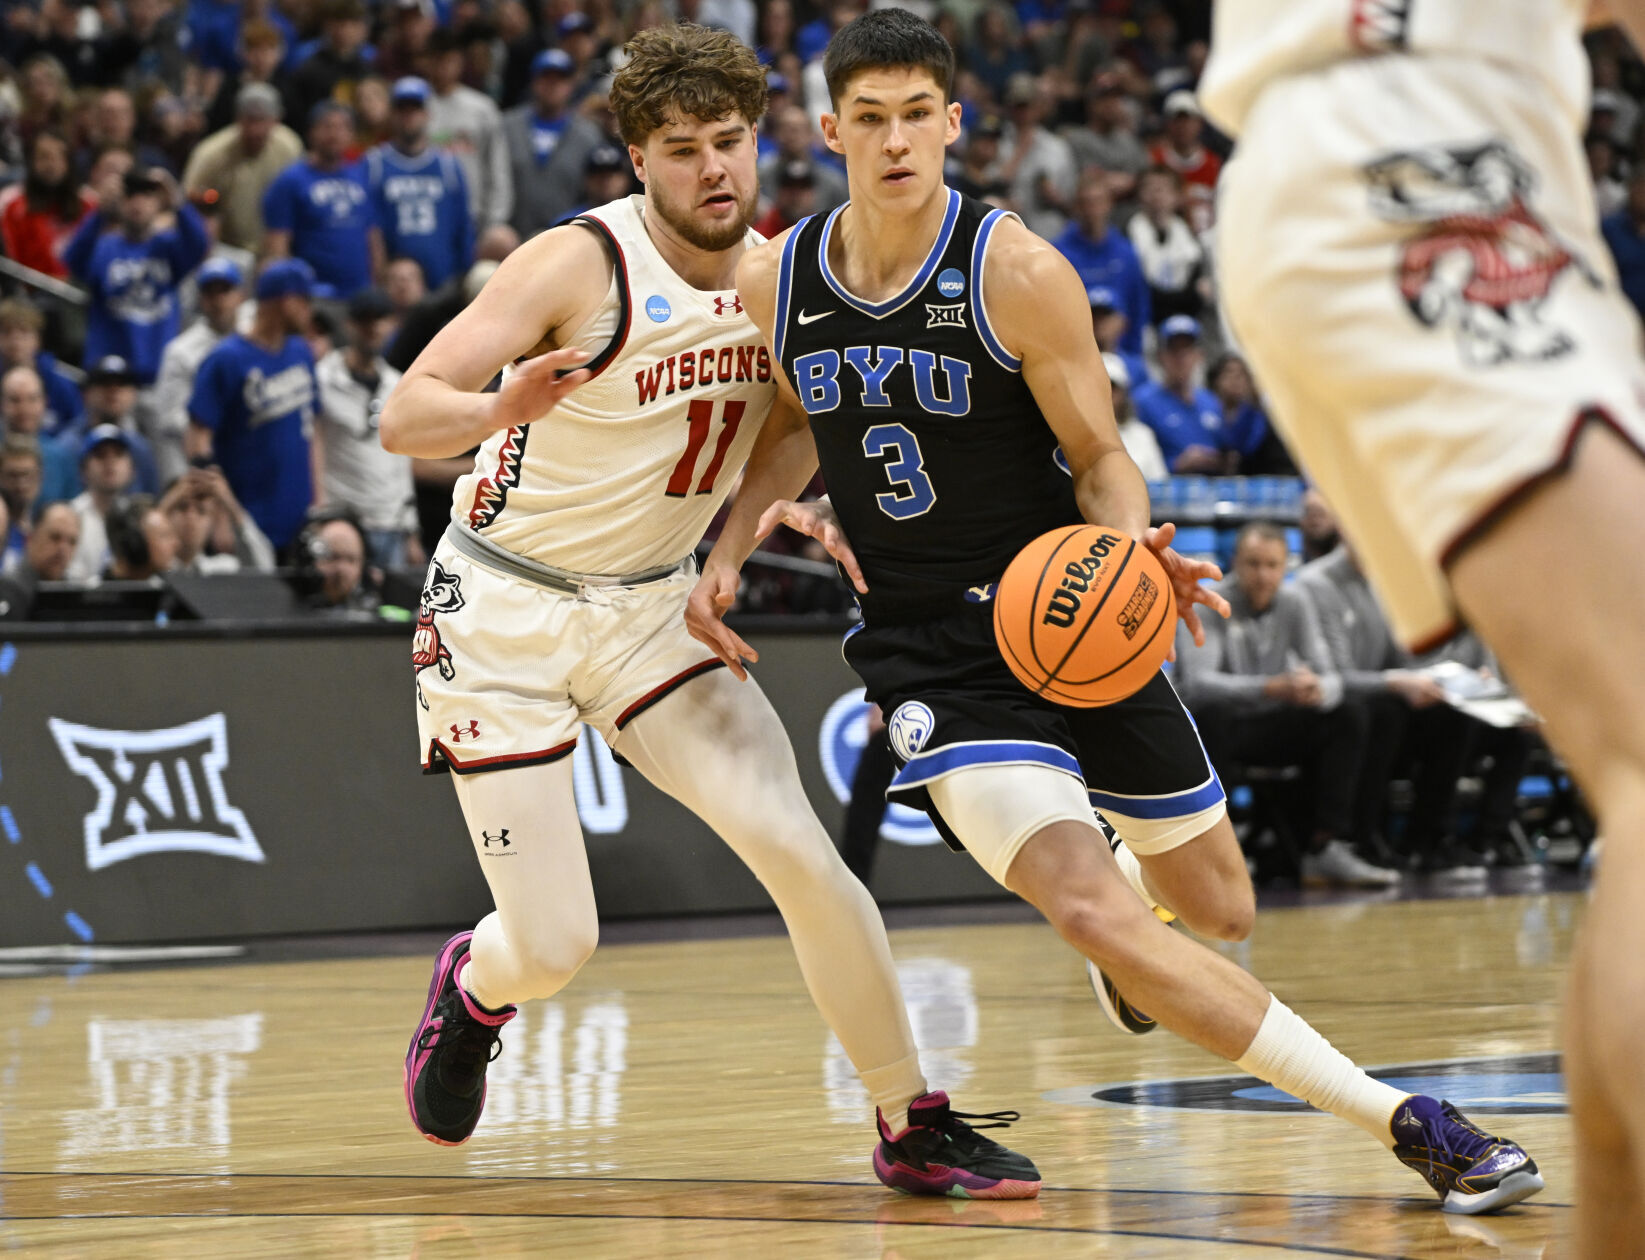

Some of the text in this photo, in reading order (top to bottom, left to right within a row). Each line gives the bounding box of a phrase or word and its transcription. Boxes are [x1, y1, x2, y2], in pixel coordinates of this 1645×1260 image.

[650, 307, 670, 316] NCAA
[941, 281, 964, 290] NCAA
[635, 345, 777, 406] WISCONS
[793, 345, 972, 417] BYU
[664, 399, 747, 498] 11
[862, 422, 937, 521] 3
[1042, 533, 1122, 629] Wilson
